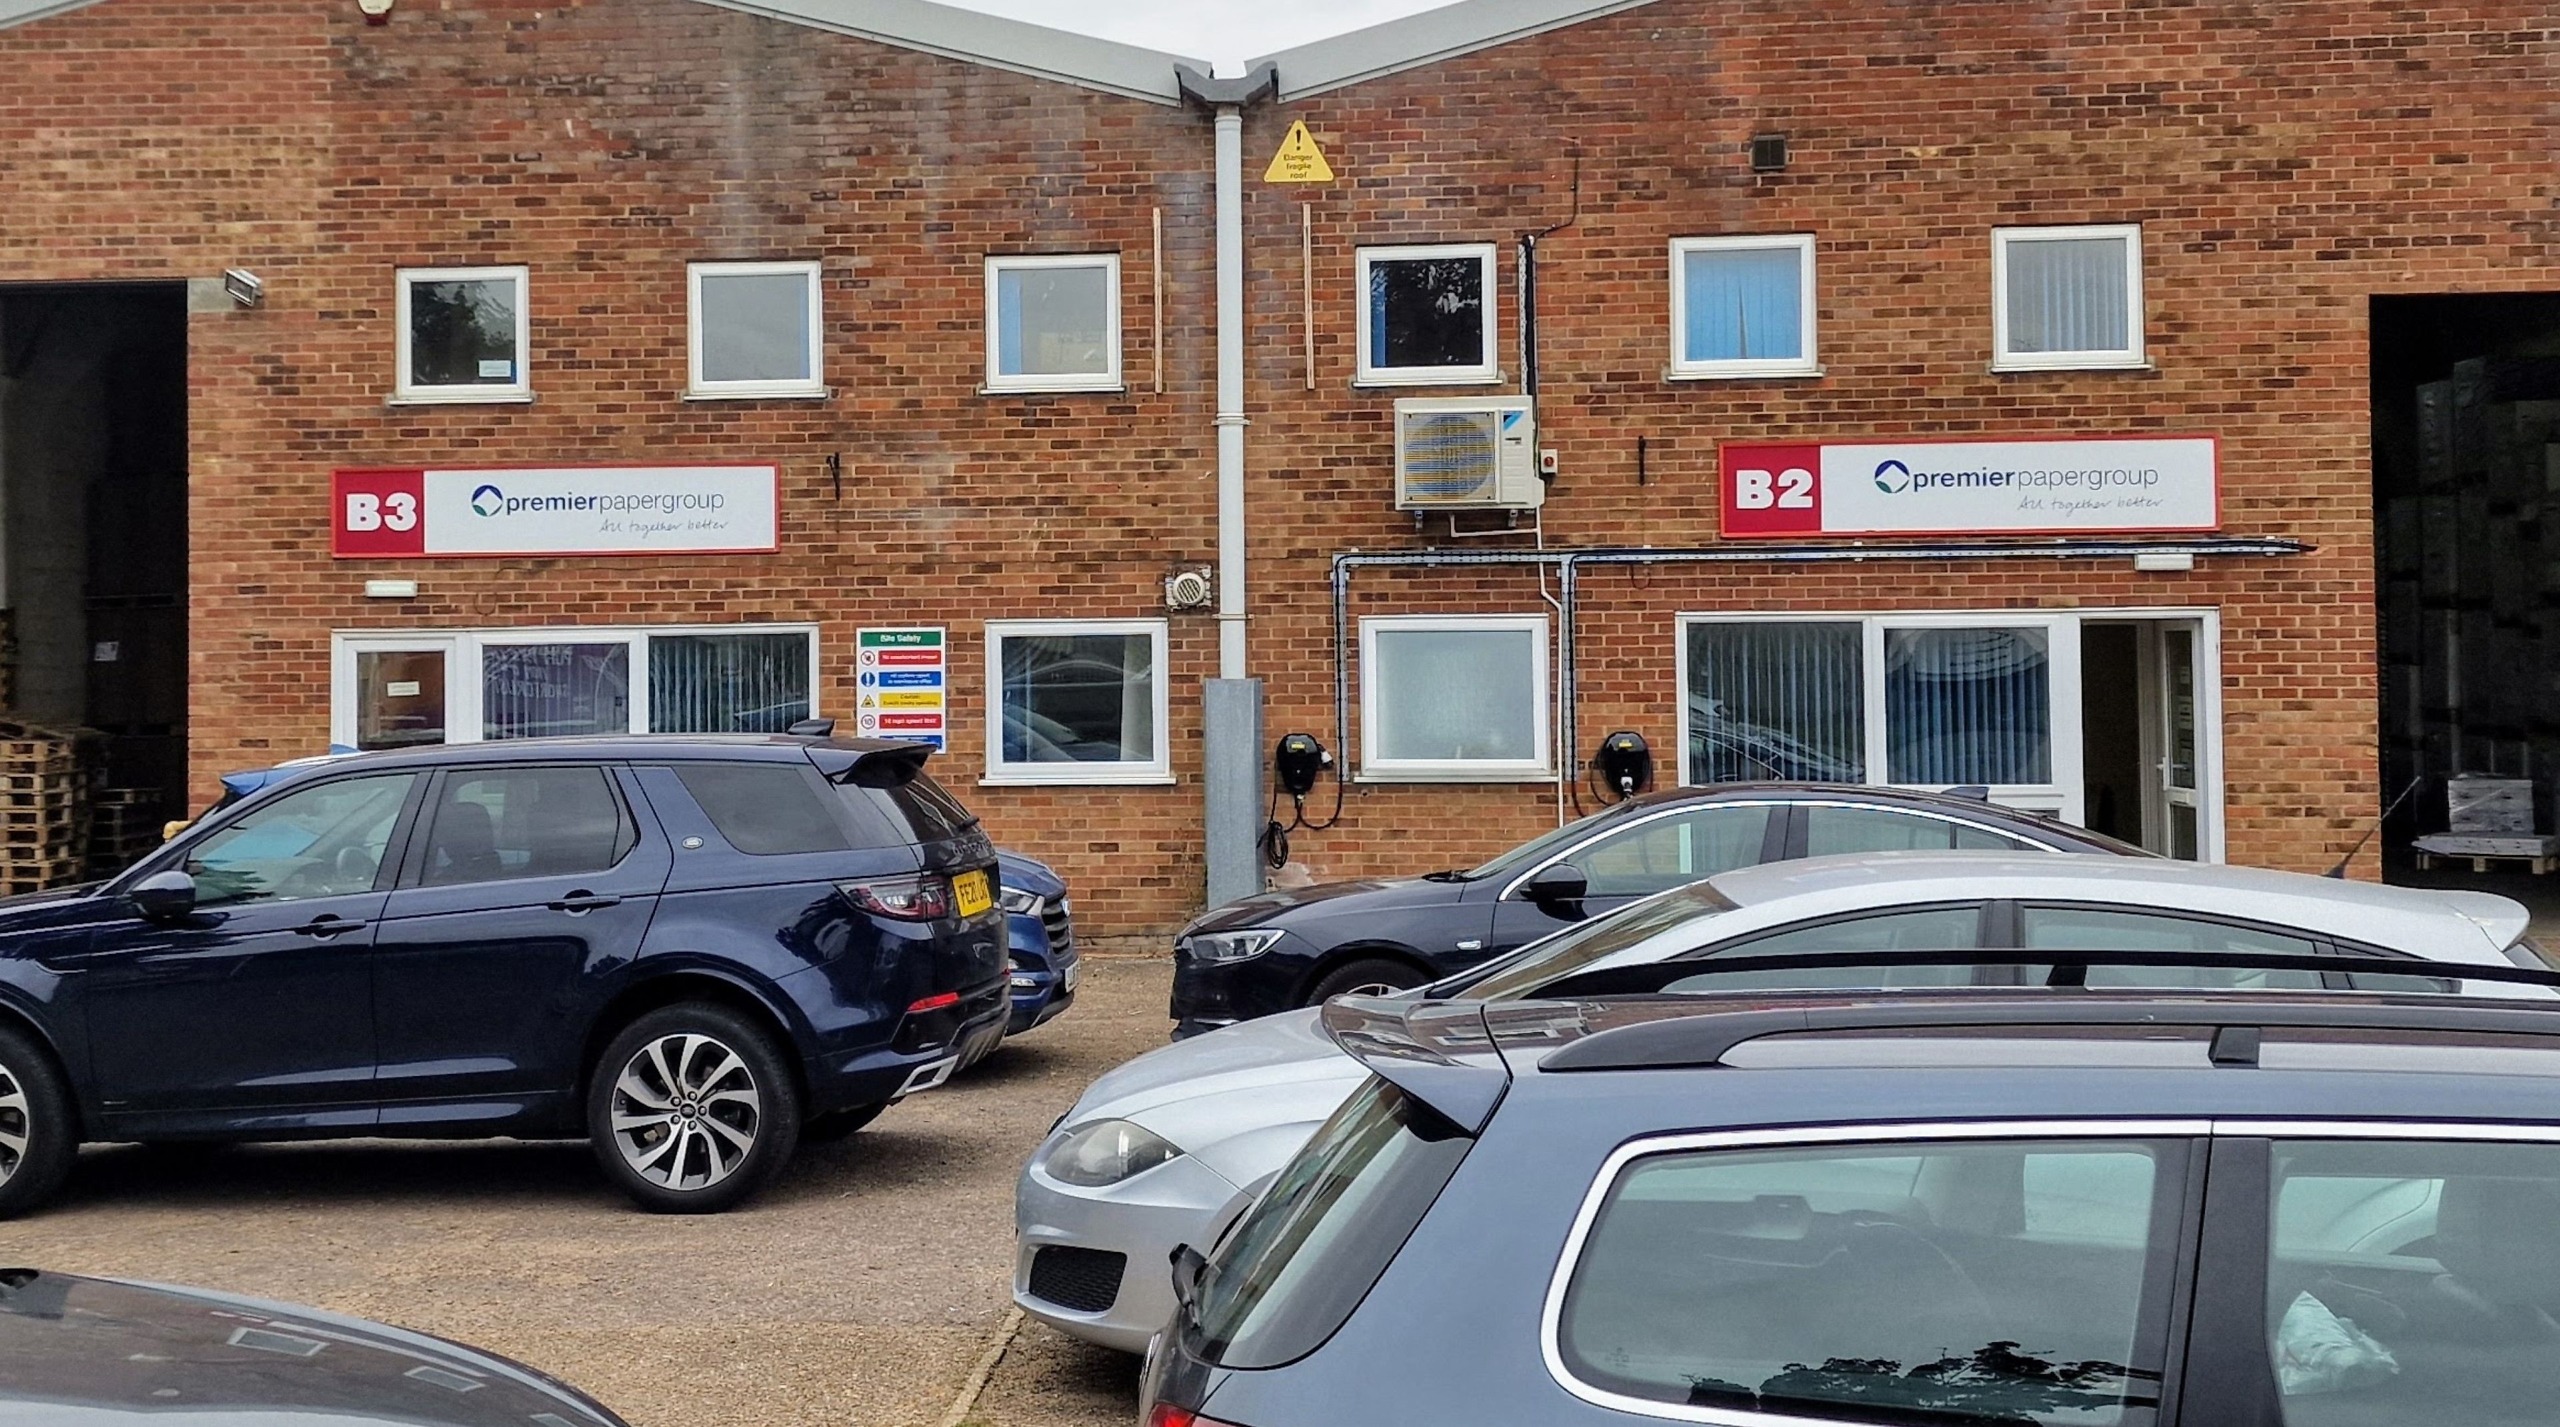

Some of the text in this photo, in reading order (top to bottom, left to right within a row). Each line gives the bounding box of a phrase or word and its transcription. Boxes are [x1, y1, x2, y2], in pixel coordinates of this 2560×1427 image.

[1283, 154, 1313, 162] Danger
[1286, 163, 1312, 171] fragile
[1290, 171, 1308, 179] roof
[1736, 468, 1814, 509] B2
[1913, 467, 2159, 492] premierpapergroup
[346, 492, 418, 532] B3
[506, 491, 725, 516] premierpapergroup
[2051, 496, 2112, 518] together
[2117, 496, 2164, 508] better
[628, 519, 683, 539] together
[687, 519, 729, 531] better
